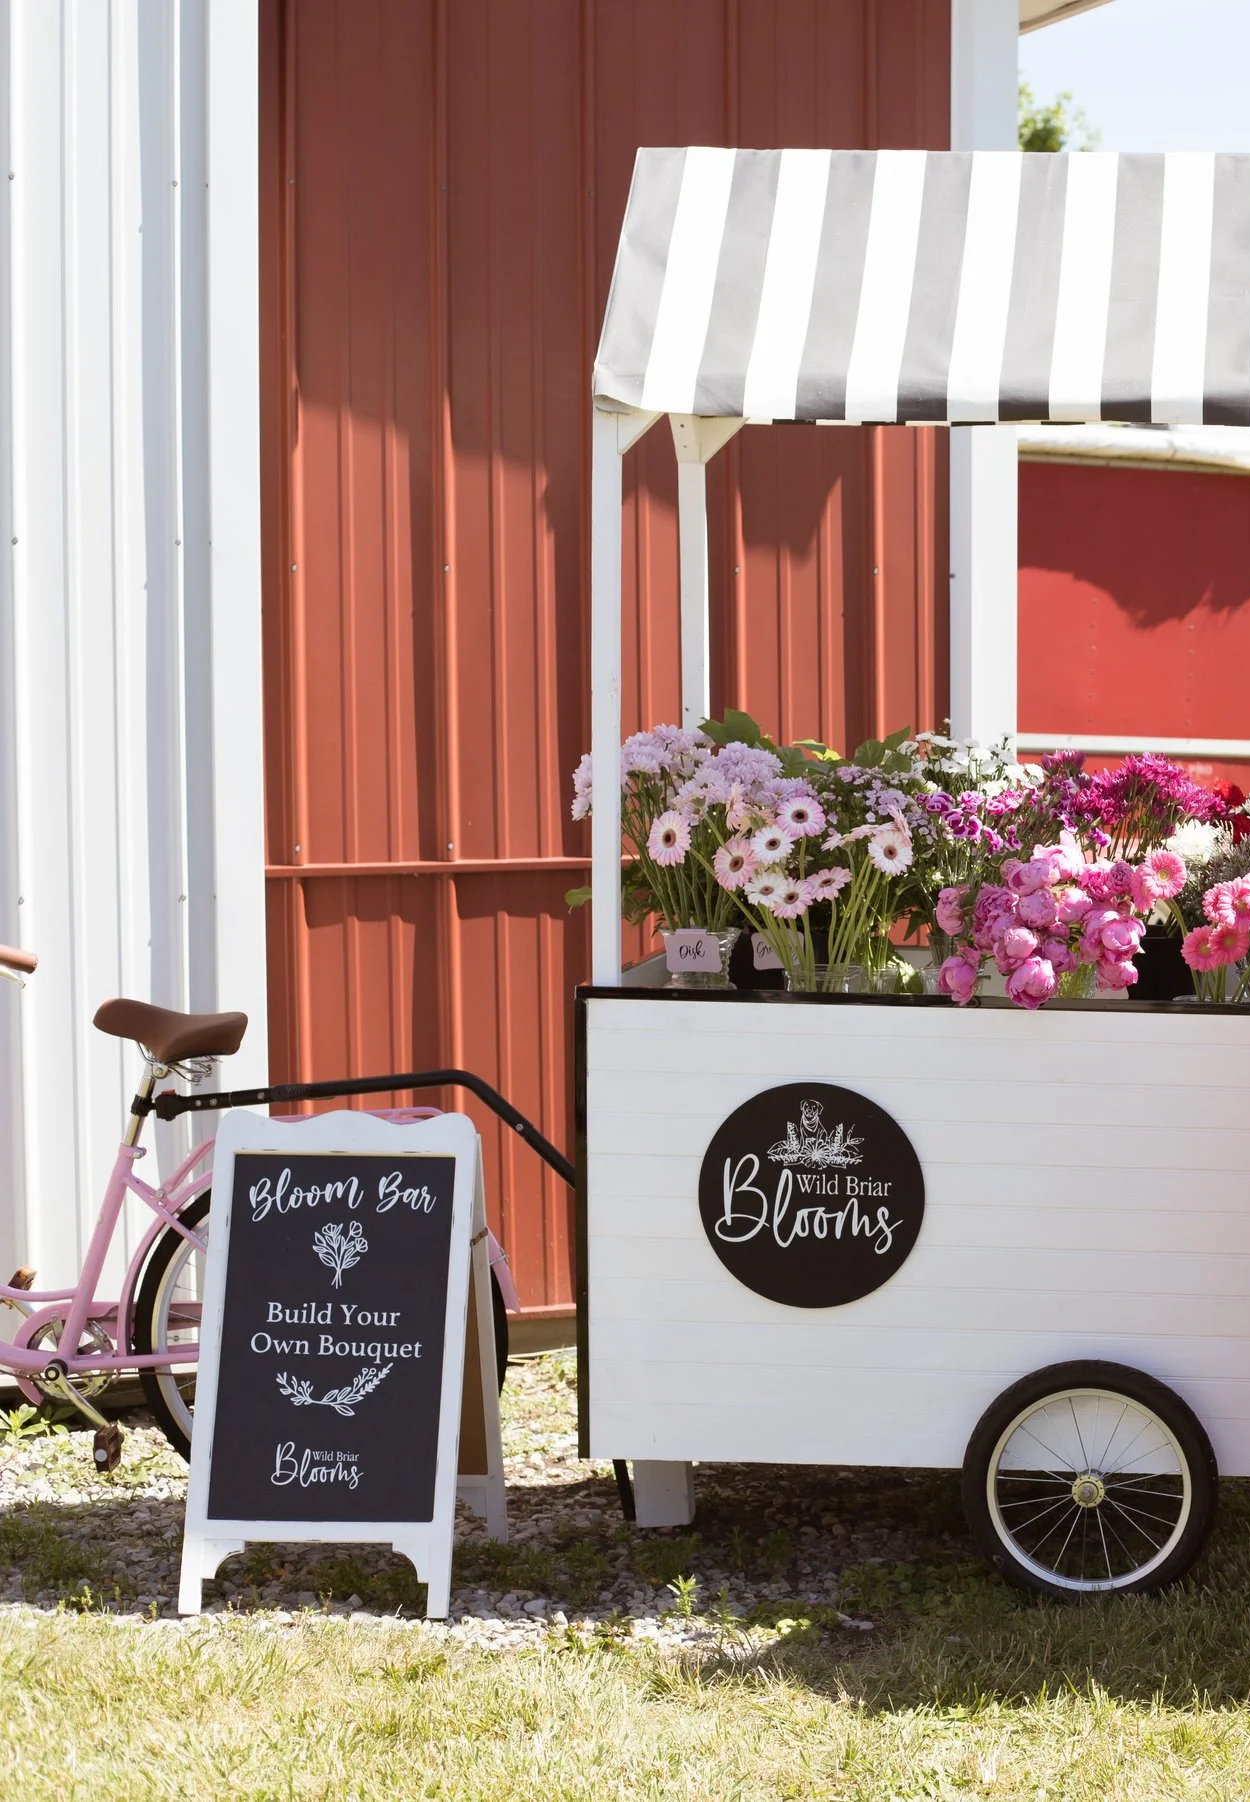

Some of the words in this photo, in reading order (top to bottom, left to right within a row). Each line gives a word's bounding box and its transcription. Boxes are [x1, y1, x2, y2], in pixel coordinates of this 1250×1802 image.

[679, 940, 706, 960] Disk
[249, 1168, 364, 1222] Bloom
[376, 1171, 437, 1214] Bar
[797, 1174, 839, 1195] Wild
[846, 1176, 892, 1197] Briar
[714, 1153, 904, 1254] Blooms
[266, 1302, 334, 1326] Build
[340, 1304, 401, 1327] Your
[250, 1331, 310, 1356] Own
[317, 1335, 422, 1363] Bouquet
[270, 1441, 364, 1490] Blooms
[312, 1450, 334, 1462] Wild
[336, 1451, 360, 1462] Briar
